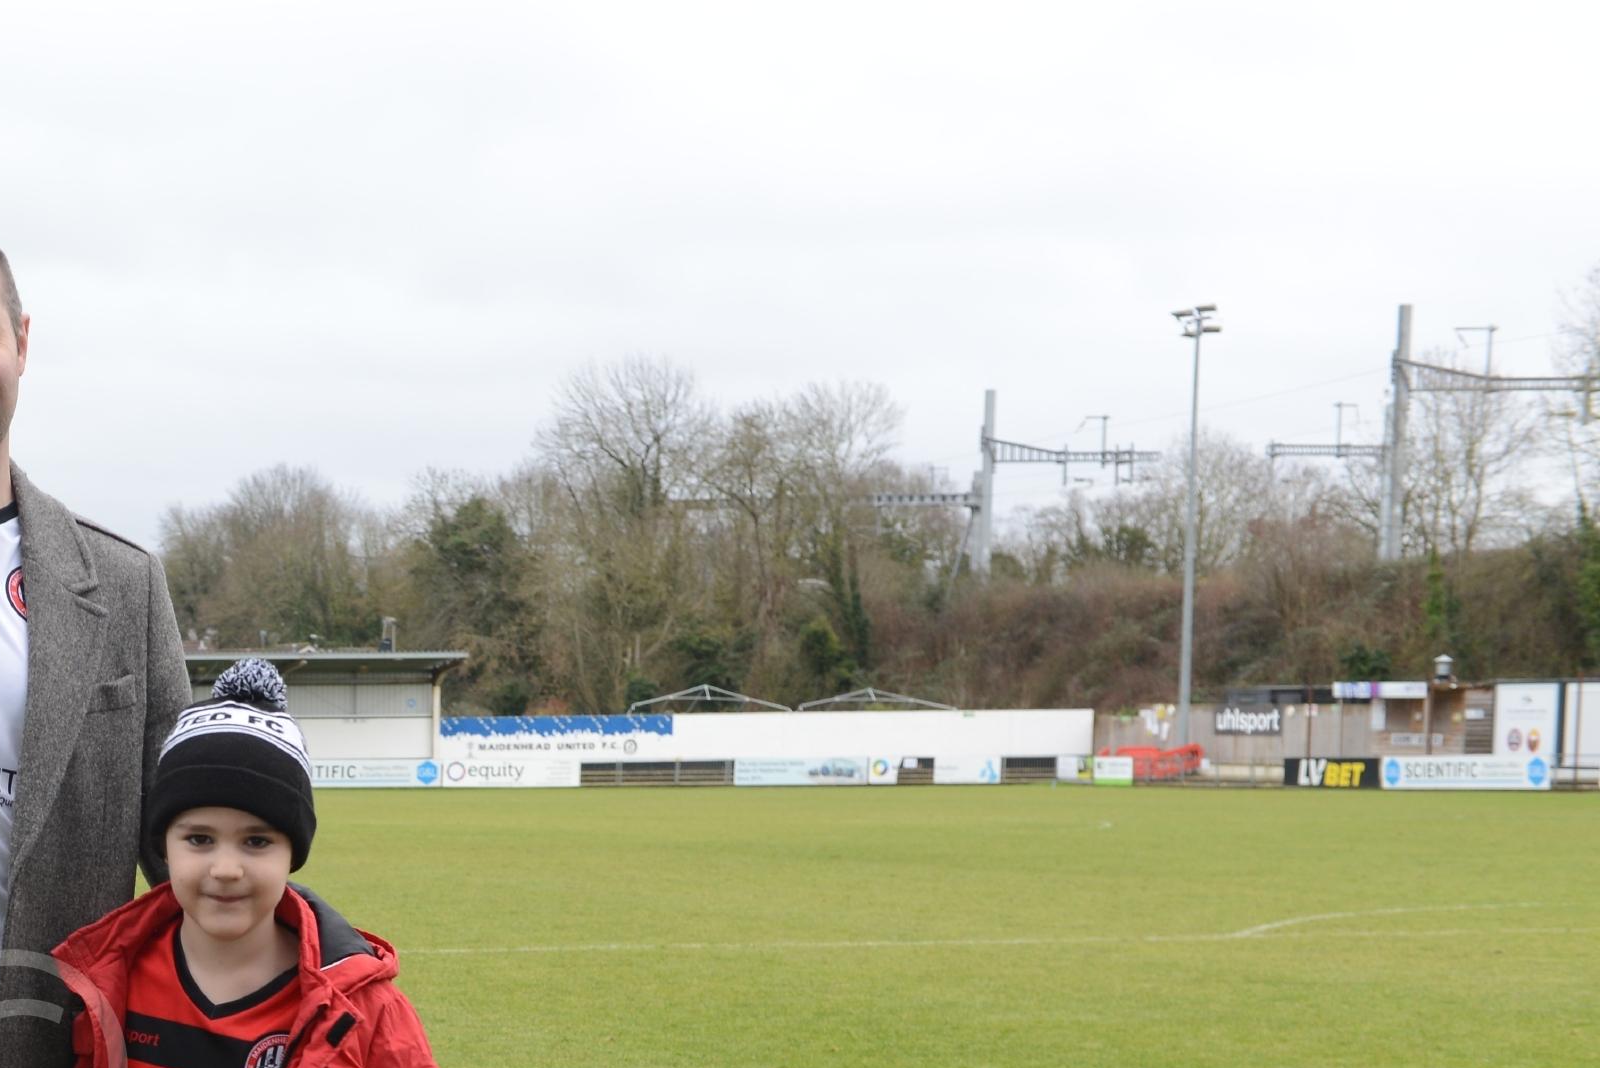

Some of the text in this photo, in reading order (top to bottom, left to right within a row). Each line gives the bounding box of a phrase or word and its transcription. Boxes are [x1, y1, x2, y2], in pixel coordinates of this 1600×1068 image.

[248, 715, 284, 734] FC
[1215, 707, 1280, 734] uhlsport
[478, 743, 551, 751] MAIDENHEAD
[557, 742, 596, 750] UNITED
[310, 765, 356, 778] TIFIC
[467, 763, 525, 782] equity
[1405, 762, 1478, 779] SCIENTIFIC
